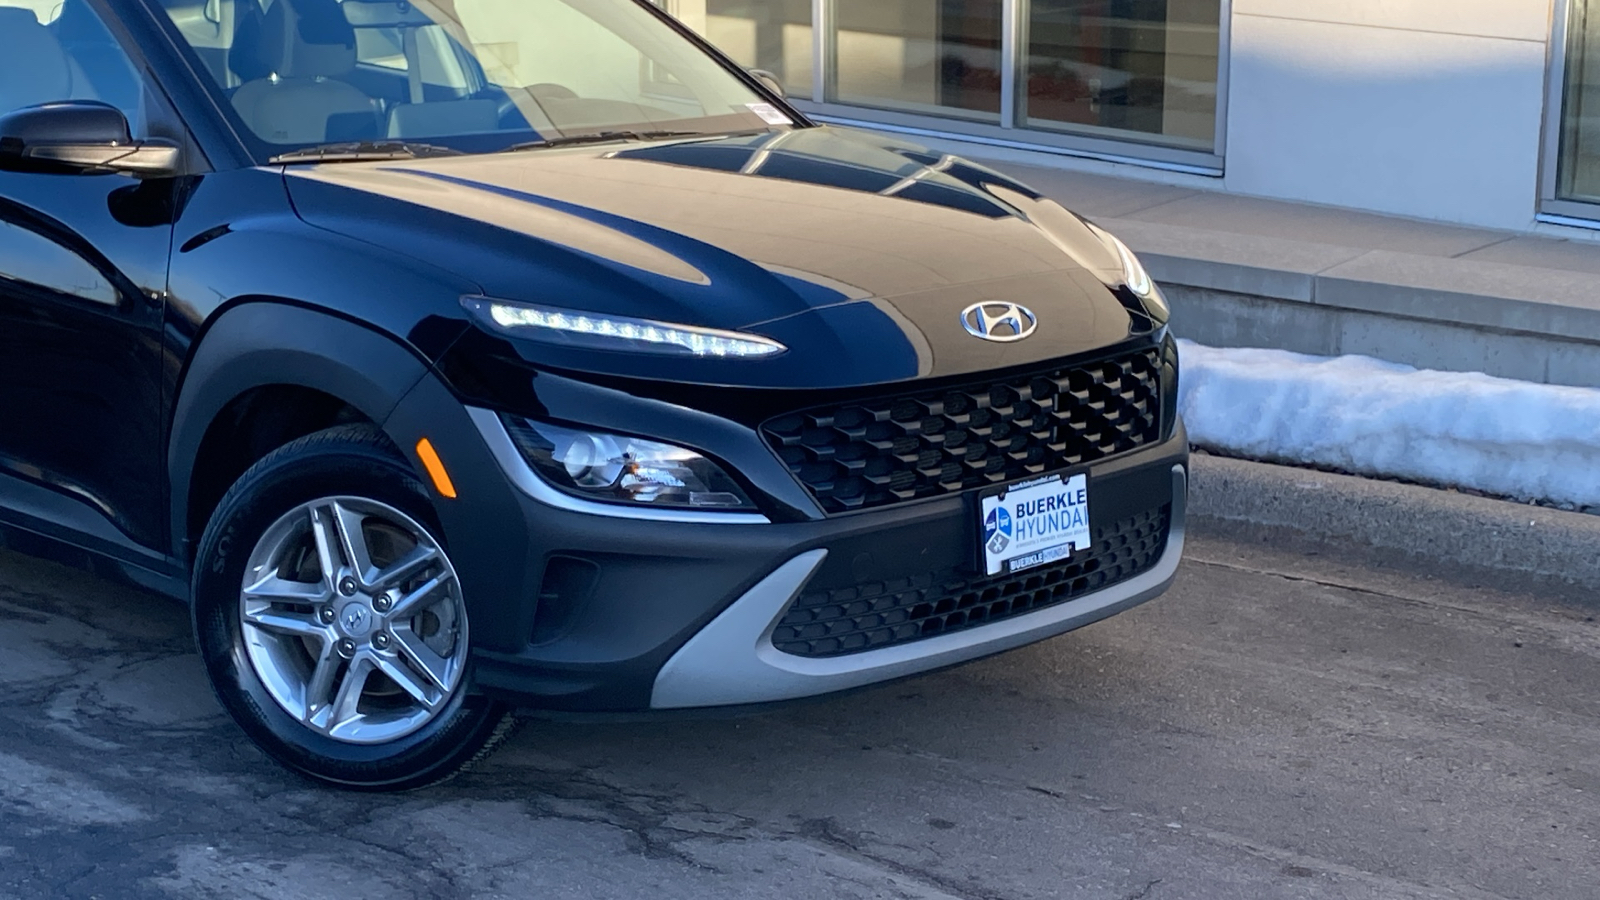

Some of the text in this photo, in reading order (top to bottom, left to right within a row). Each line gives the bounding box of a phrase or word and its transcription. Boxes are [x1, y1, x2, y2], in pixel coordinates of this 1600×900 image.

[1016, 489, 1086, 519] BUERKLE
[1016, 506, 1088, 542] HYUNDAI
[1010, 553, 1043, 571] BUERKLE
